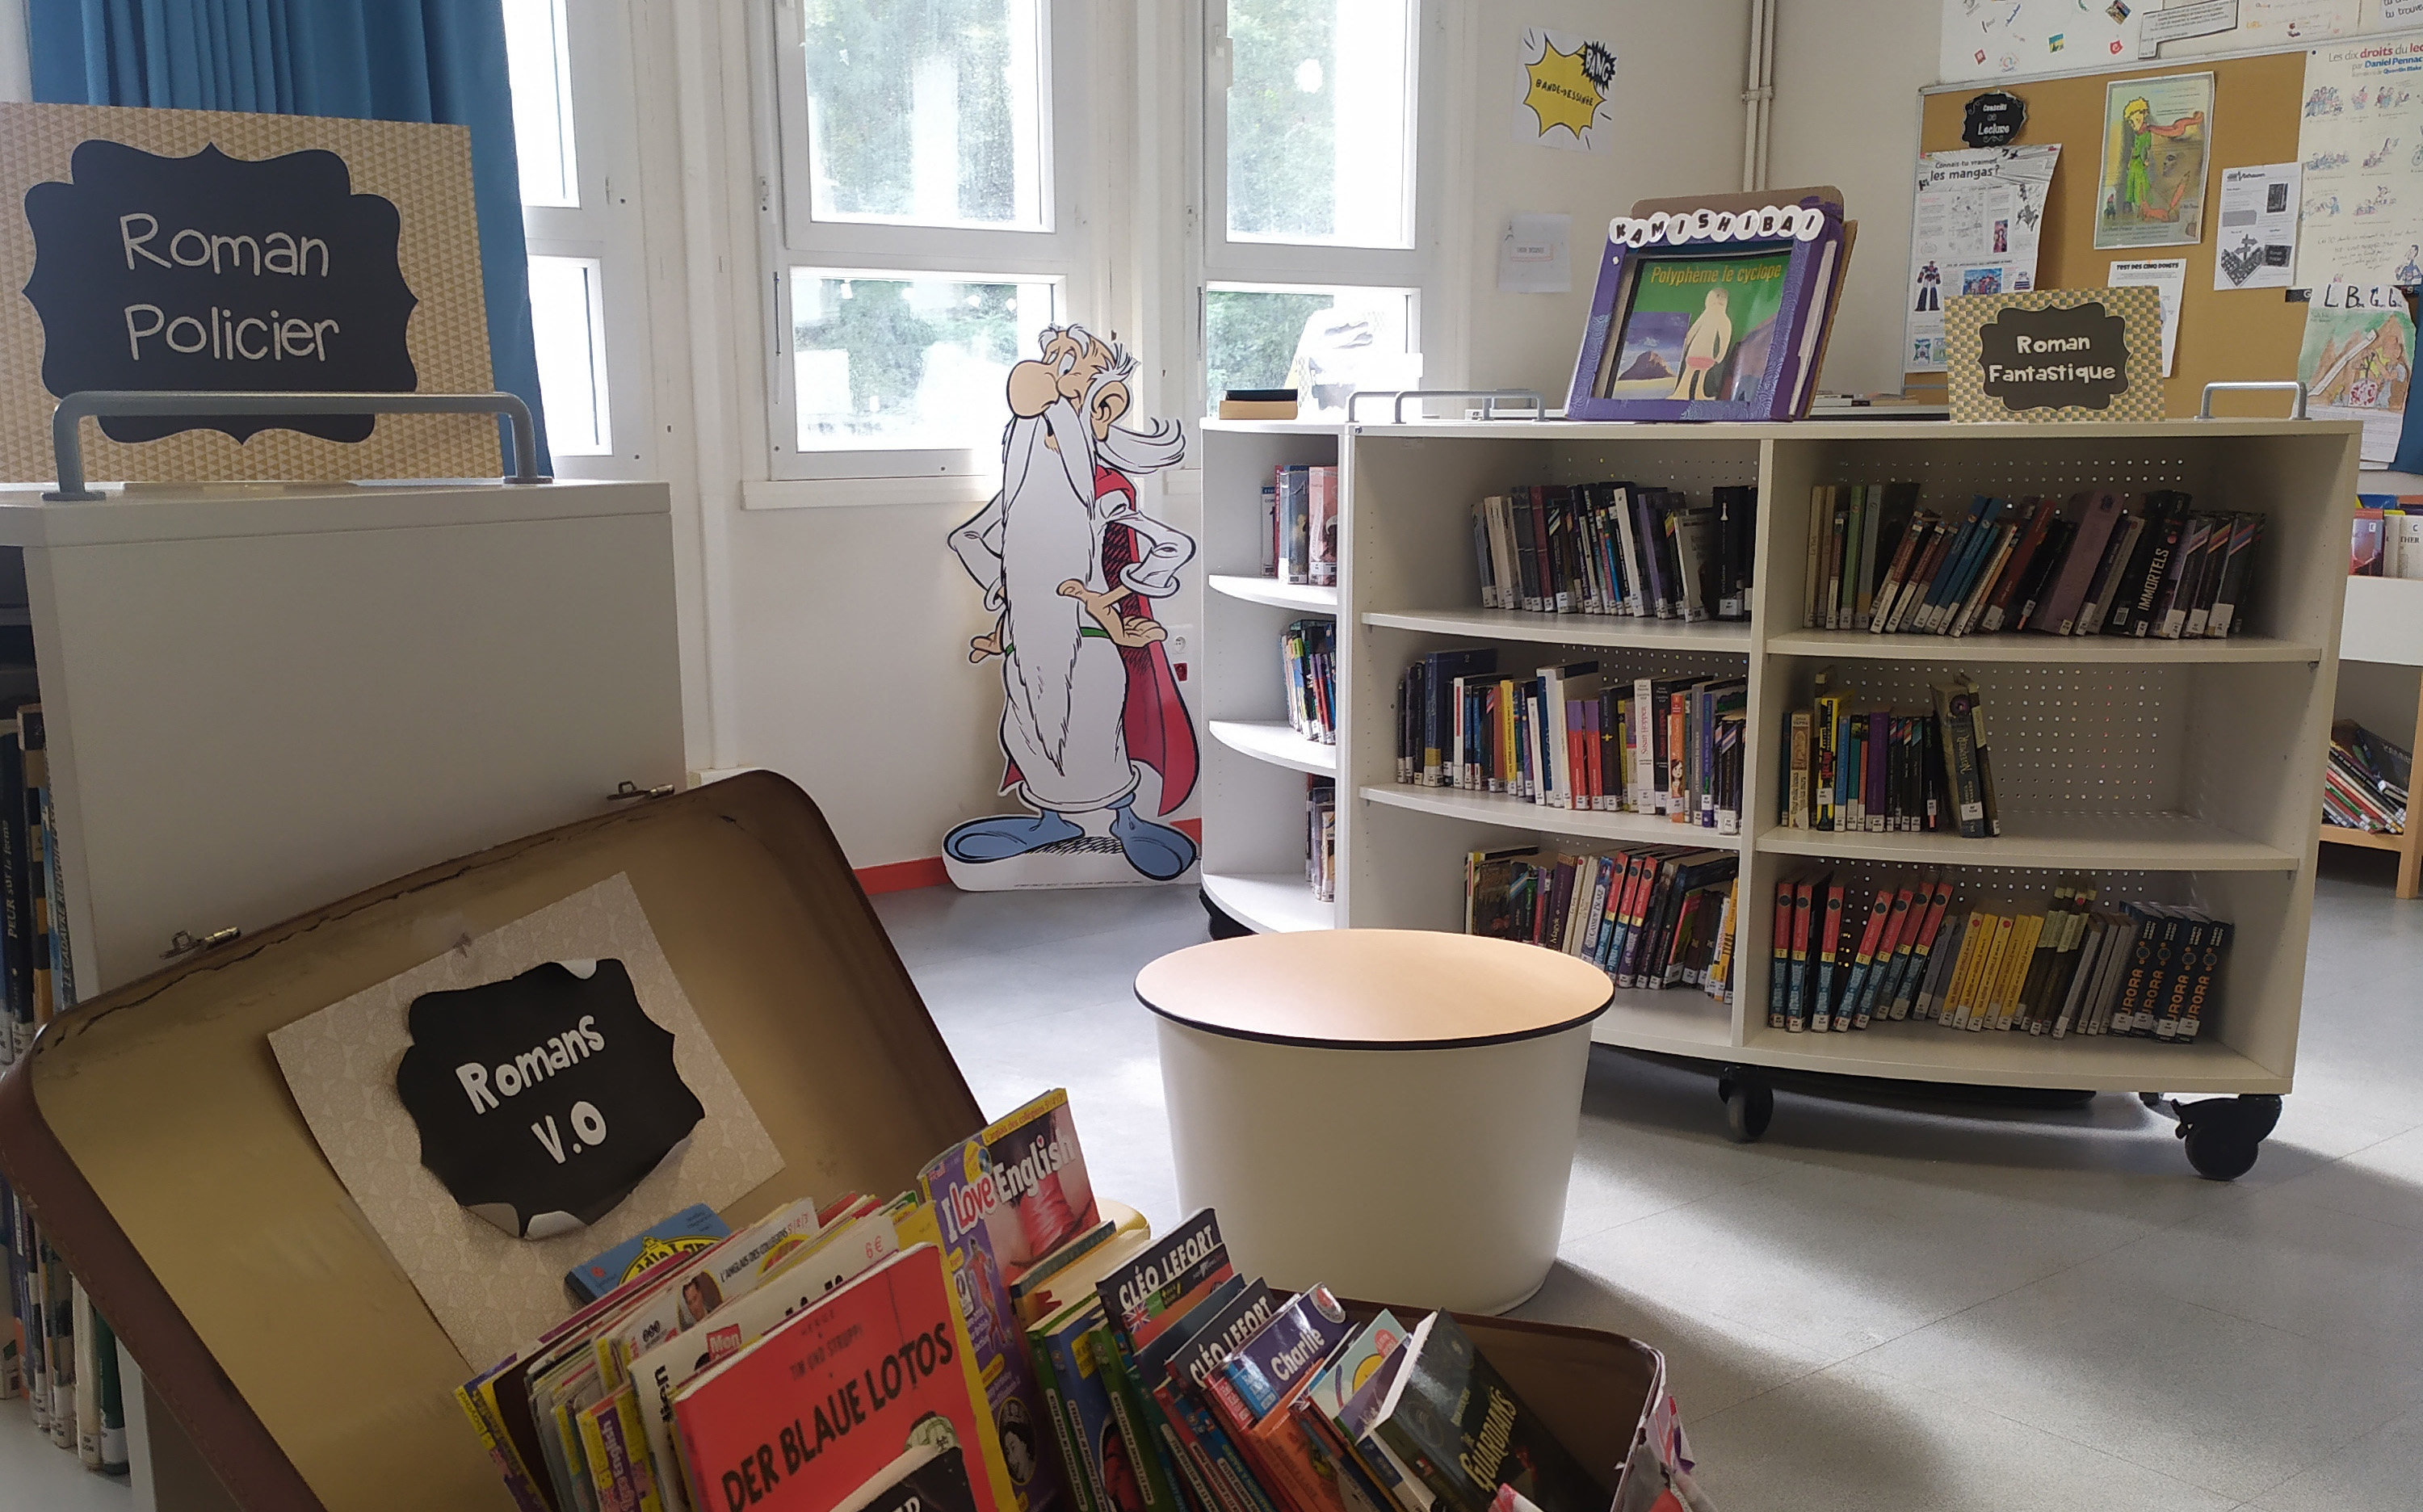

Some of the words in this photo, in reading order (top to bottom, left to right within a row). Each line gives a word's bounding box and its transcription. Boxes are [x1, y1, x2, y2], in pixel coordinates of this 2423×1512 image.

[1585, 48, 1611, 82] BANG
[2329, 52, 2342, 62] Les
[2345, 50, 2358, 61] dix
[2360, 47, 2393, 58] droits
[2396, 44, 2408, 55] du
[2365, 58, 2391, 68] Daniel
[1978, 123, 2010, 136] Lecture
[1930, 170, 1945, 182] les
[1949, 167, 1993, 180] mangas
[1935, 160, 1959, 169] Connais
[119, 212, 330, 277] Roman
[1615, 212, 1816, 244] KAMISHIBAI
[1650, 266, 1719, 287] Polyphème
[1721, 266, 1733, 282] le
[1736, 264, 1782, 284] cyclope
[124, 304, 340, 362] Policier
[2017, 335, 2090, 354] Roman
[1988, 363, 2116, 384] Fantastique
[2133, 546, 2175, 612] IMMORTELS
[5, 899, 17, 939] PEUR
[56, 905, 70, 969] CADAVRE
[2122, 968, 2144, 1016] URORA
[2144, 969, 2165, 1015] URORA
[2167, 973, 2188, 1022] URORA
[2191, 975, 2210, 1021] RORA
[455, 1015, 605, 1115] Romans
[531, 1101, 607, 1165] V.O
[993, 1128, 1076, 1205] English
[941, 1197, 959, 1244] I
[949, 1172, 997, 1235] Love
[720, 1260, 748, 1283] L'ANGLAIS
[1119, 1265, 1160, 1312] CLÉO
[1161, 1224, 1214, 1282] LEFORT
[1189, 1342, 1226, 1389] CLÉO
[1222, 1296, 1273, 1352] LEFORT
[1270, 1327, 1325, 1382] Charlie
[721, 1443, 780, 1512] DER
[779, 1378, 867, 1476] BLAUE
[865, 1321, 953, 1413] LOTOS
[1459, 1385, 1518, 1493] GUARDIANS
